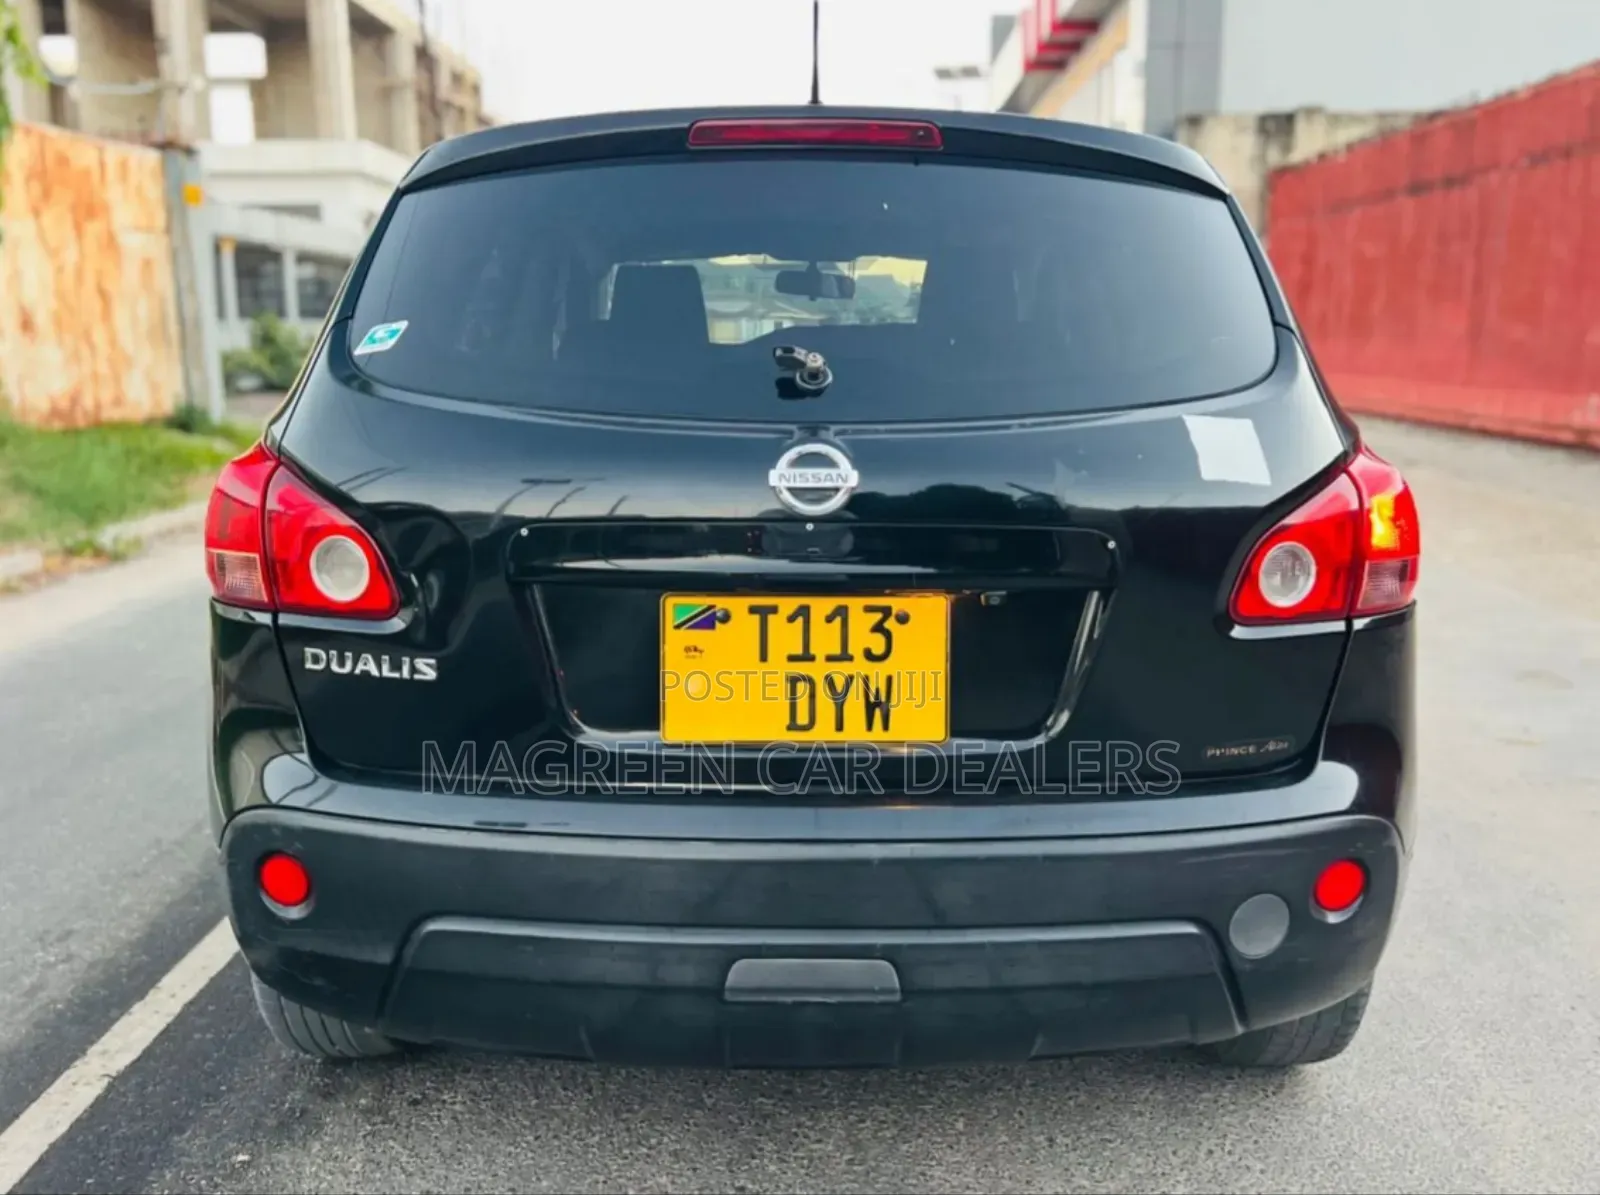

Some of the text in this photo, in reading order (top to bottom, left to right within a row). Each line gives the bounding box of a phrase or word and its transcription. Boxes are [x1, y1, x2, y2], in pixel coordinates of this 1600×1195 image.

[778, 472, 849, 484] NISSAN
[748, 604, 894, 663] T113
[303, 647, 438, 681] DUALIS
[785, 674, 893, 732] DYW
